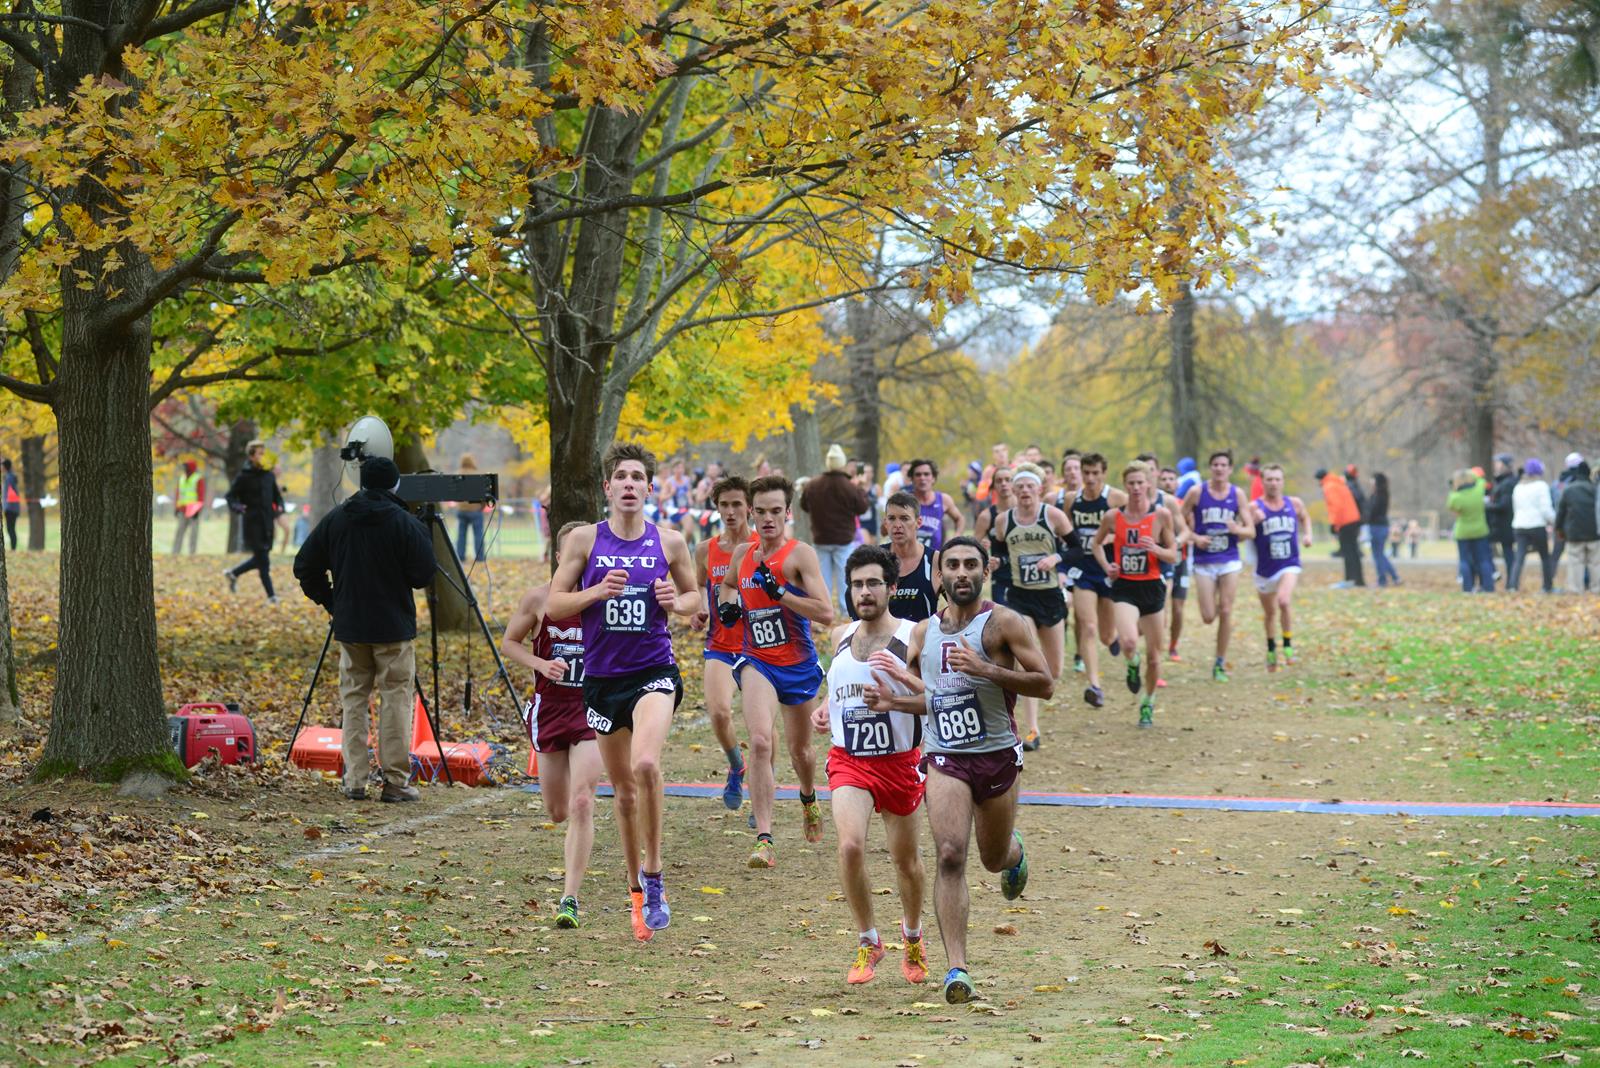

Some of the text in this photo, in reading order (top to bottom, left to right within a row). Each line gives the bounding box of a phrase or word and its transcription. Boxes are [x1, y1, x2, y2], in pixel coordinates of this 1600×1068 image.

[1024, 532, 1046, 542] OLAF
[1126, 528, 1140, 544] N
[595, 556, 657, 568] NYU
[1121, 555, 1146, 572] 667
[606, 599, 646, 626] 639
[752, 618, 786, 645] 681
[554, 657, 586, 682] 17
[835, 686, 846, 702] ST.
[956, 694, 975, 702] COUNTRY
[587, 710, 609, 732] 639
[938, 708, 981, 741] 689
[847, 722, 890, 751] 720
[934, 755, 946, 766] R
